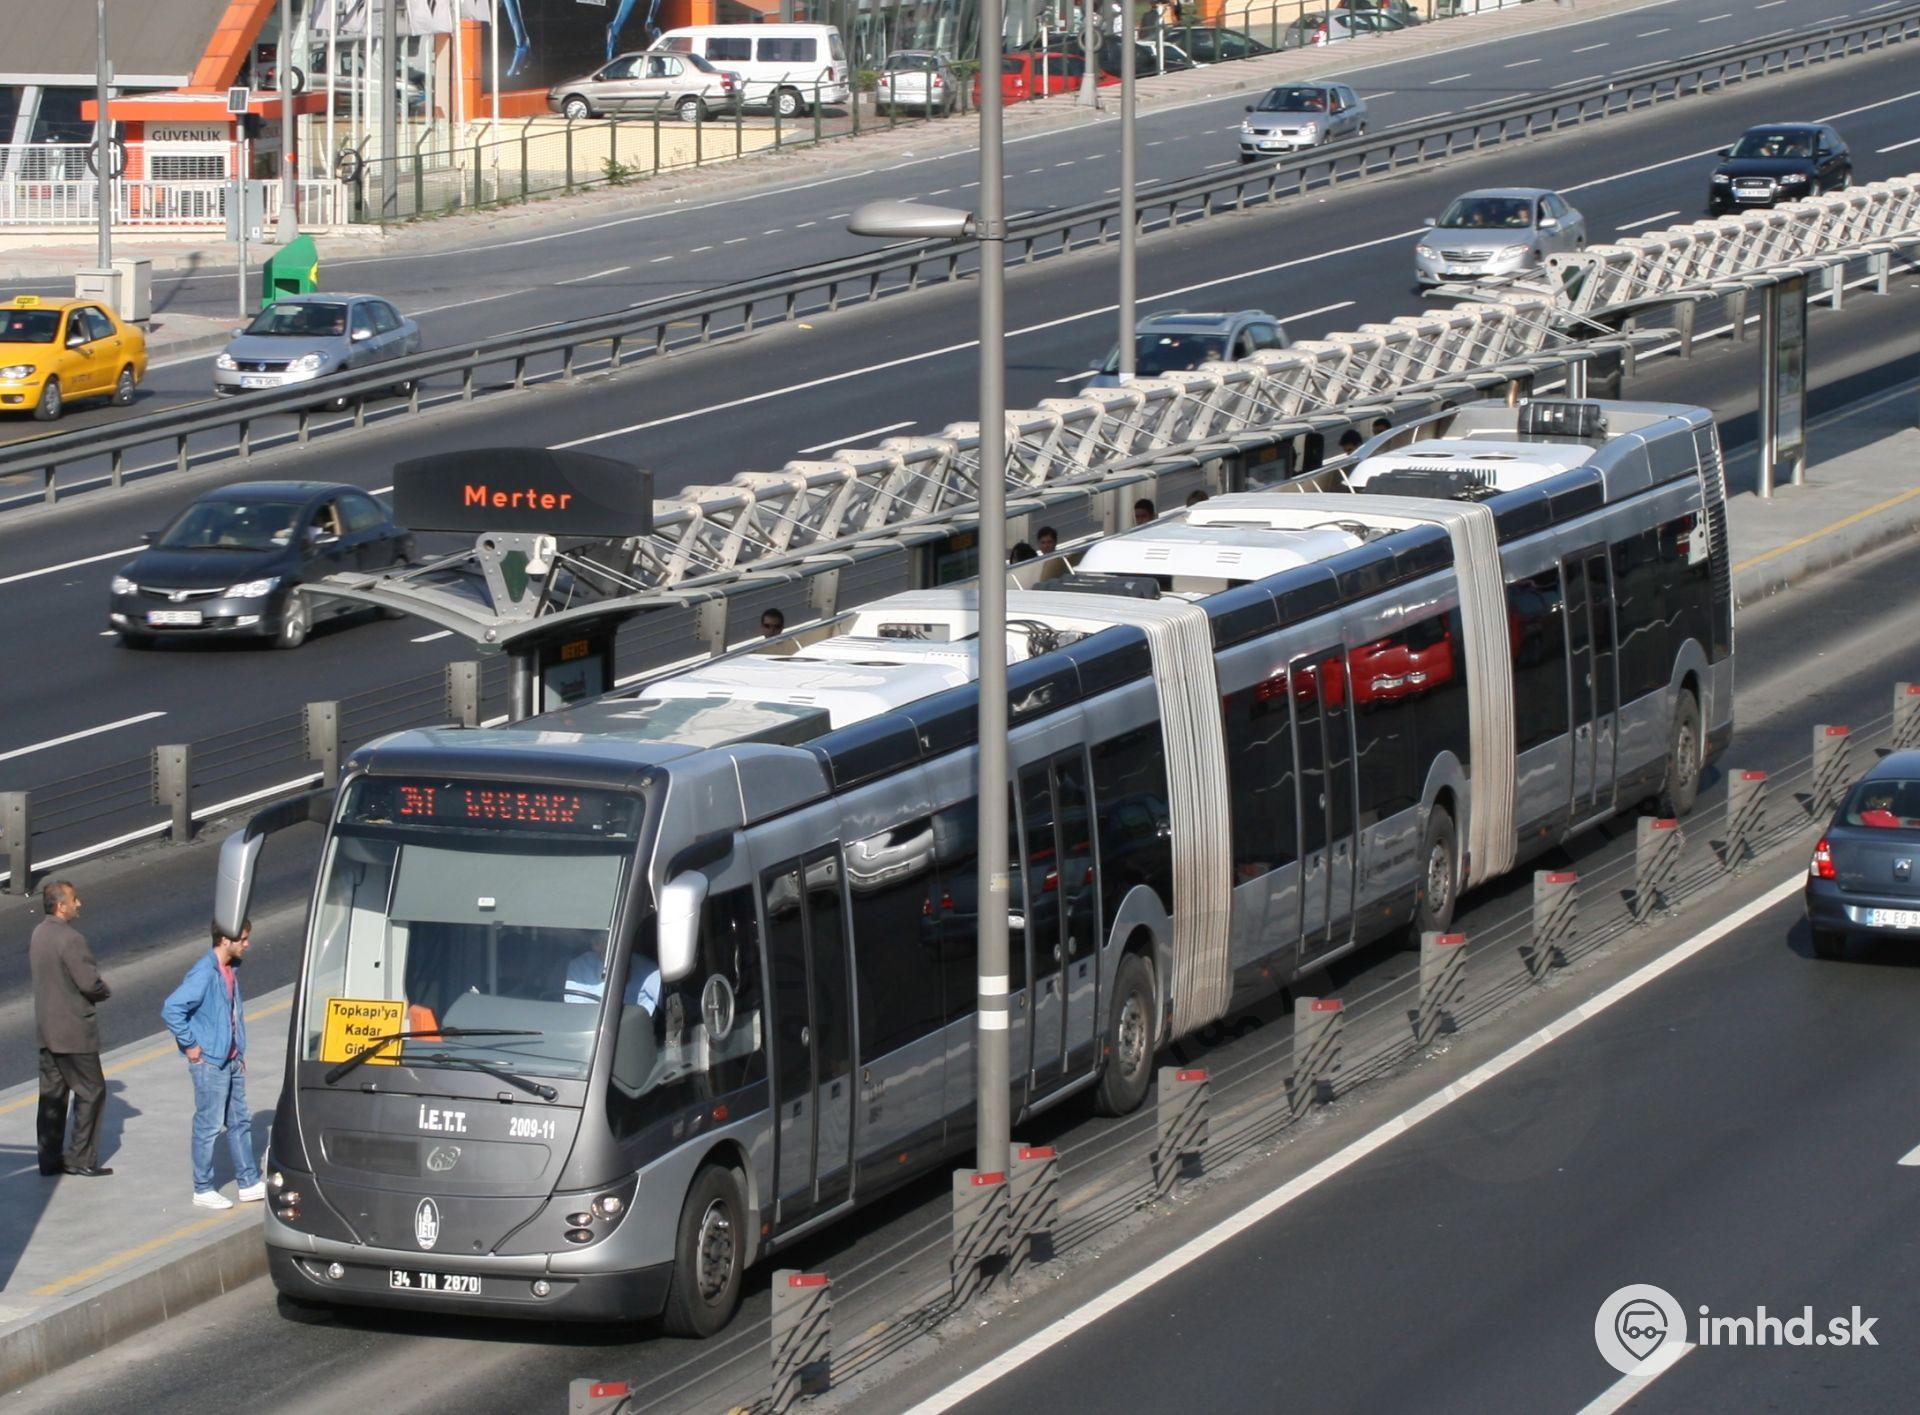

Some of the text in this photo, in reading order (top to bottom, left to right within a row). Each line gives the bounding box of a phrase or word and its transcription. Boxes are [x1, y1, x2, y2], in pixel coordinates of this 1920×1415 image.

[152, 127, 221, 141] GÜVENLİK
[464, 485, 572, 509] Merter
[345, 1024, 382, 1037] Kadar
[344, 1042, 372, 1056] Gid
[509, 1117, 556, 1140] 2009-11
[393, 1270, 478, 1292] 34 TN 2870
